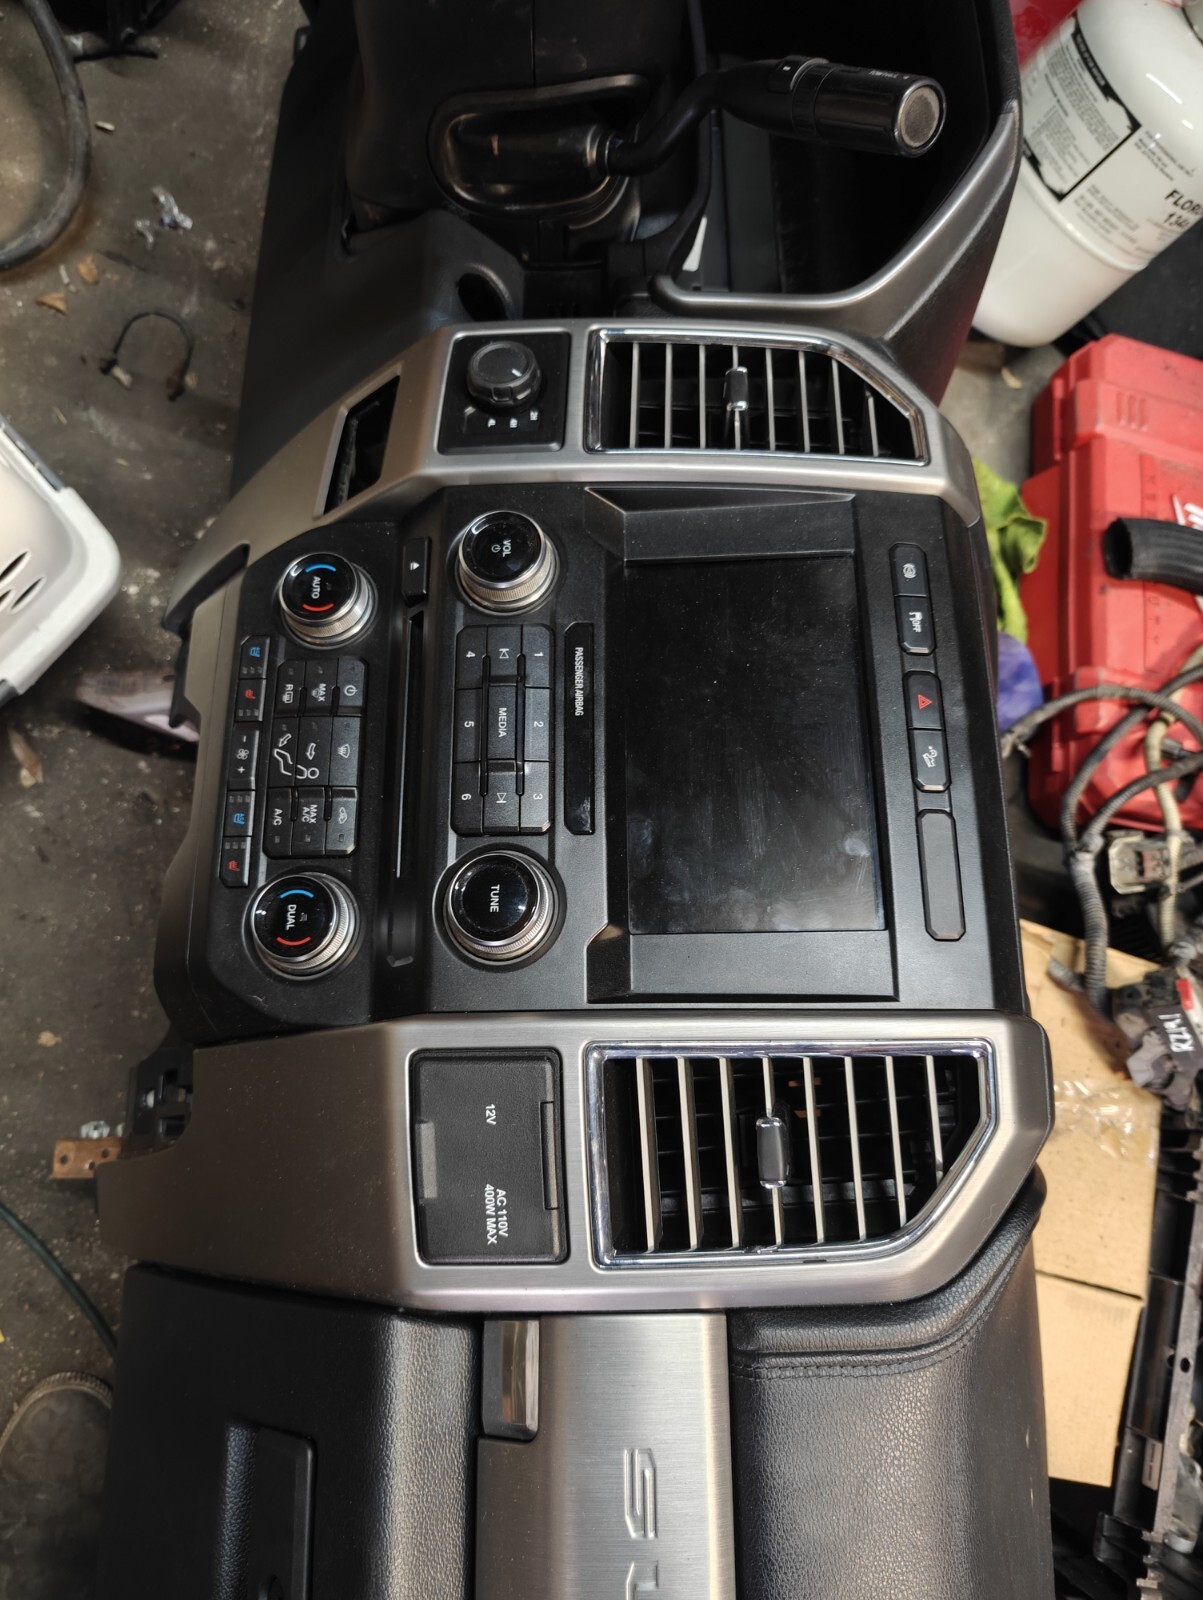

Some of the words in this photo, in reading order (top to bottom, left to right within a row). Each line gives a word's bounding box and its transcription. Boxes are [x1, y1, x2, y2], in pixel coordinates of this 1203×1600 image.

[509, 418, 518, 428] 4H
[530, 410, 538, 420] 2H
[502, 540, 512, 557] VOL
[311, 576, 321, 599] AUTO
[911, 620, 922, 633] OFF
[575, 647, 584, 688] PASSENGER
[285, 683, 293, 691] R
[317, 683, 326, 702] MAX
[575, 689, 584, 716] AIRBAG
[497, 707, 508, 737] MEDIA
[273, 809, 282, 826] A/C
[302, 807, 310, 823] A/C
[309, 805, 318, 824] MAX
[489, 884, 499, 912] TUNE
[286, 904, 296, 930] DUAL
[486, 1104, 497, 1125] 12V
[484, 1184, 495, 1215] 400W
[497, 1189, 507, 1206] AC
[487, 1218, 497, 1245] MAX
[498, 1209, 508, 1237] 110V
